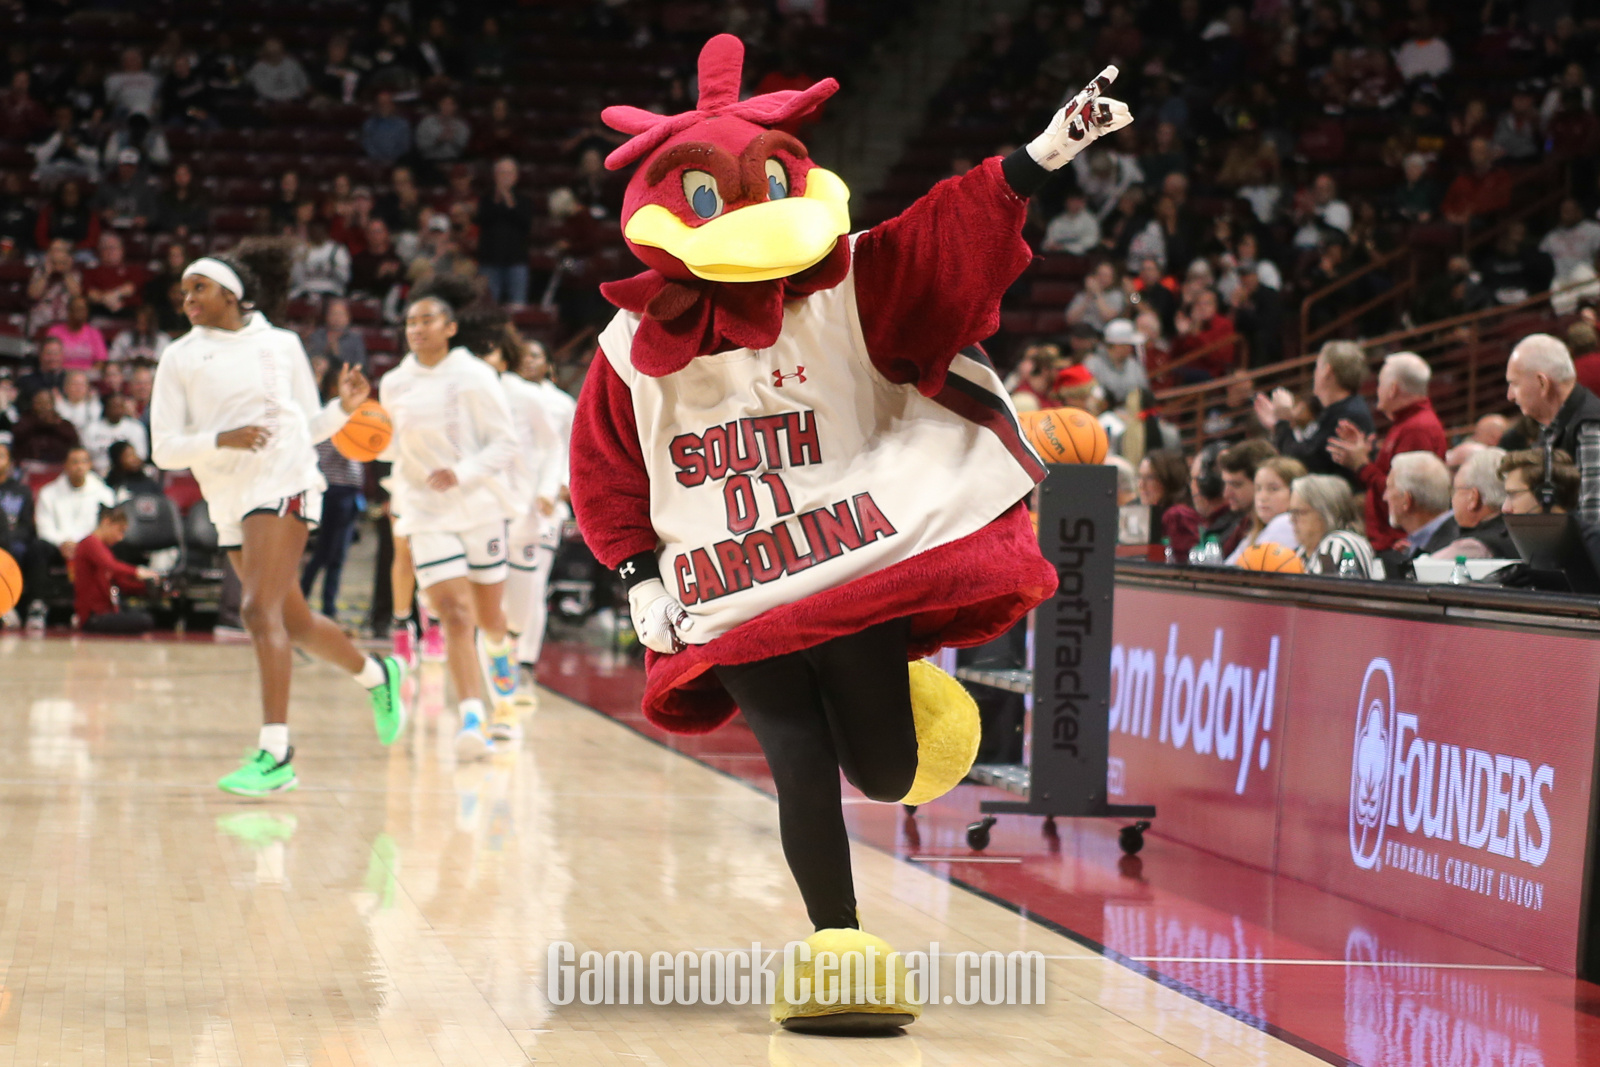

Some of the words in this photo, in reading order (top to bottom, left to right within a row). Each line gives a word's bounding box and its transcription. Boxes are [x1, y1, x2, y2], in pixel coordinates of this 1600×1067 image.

[669, 410, 822, 488] SOUTH
[1041, 414, 1066, 455] Wilson
[674, 491, 898, 607] CAROLINA
[723, 473, 795, 536] 01
[1053, 517, 1095, 758] ShotTracker
[1158, 622, 1280, 795] today!
[1387, 712, 1555, 867] FOUNDERS
[1385, 840, 1440, 880] FEDERAL
[1444, 857, 1495, 896] CREDIT
[1498, 871, 1544, 911] UNION
